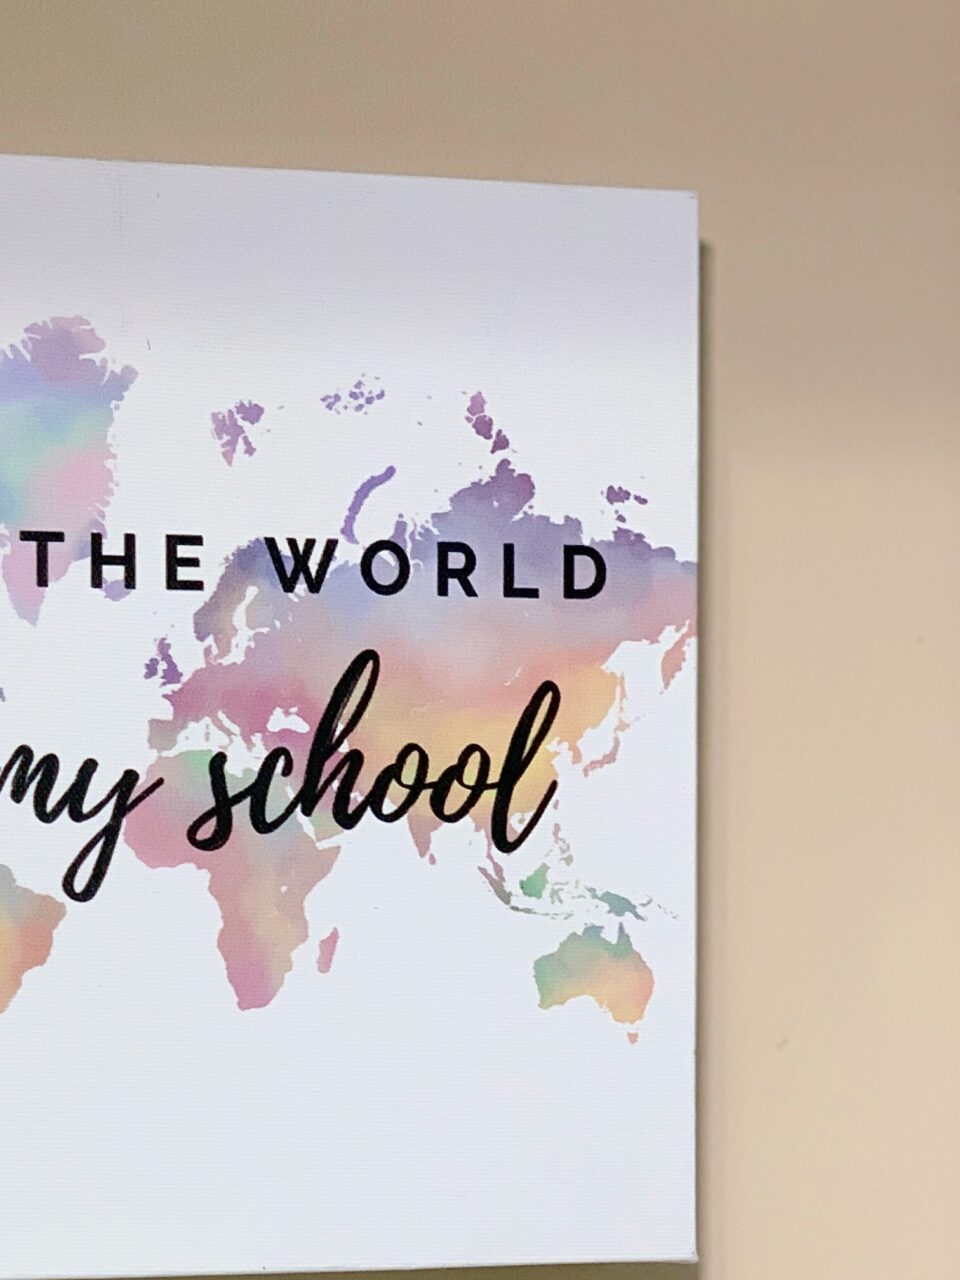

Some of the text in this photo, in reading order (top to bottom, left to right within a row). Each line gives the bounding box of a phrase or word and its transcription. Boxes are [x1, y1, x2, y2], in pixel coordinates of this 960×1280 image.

[19, 530, 205, 591] THE
[263, 536, 608, 600] WORLD
[186, 649, 562, 854] school
